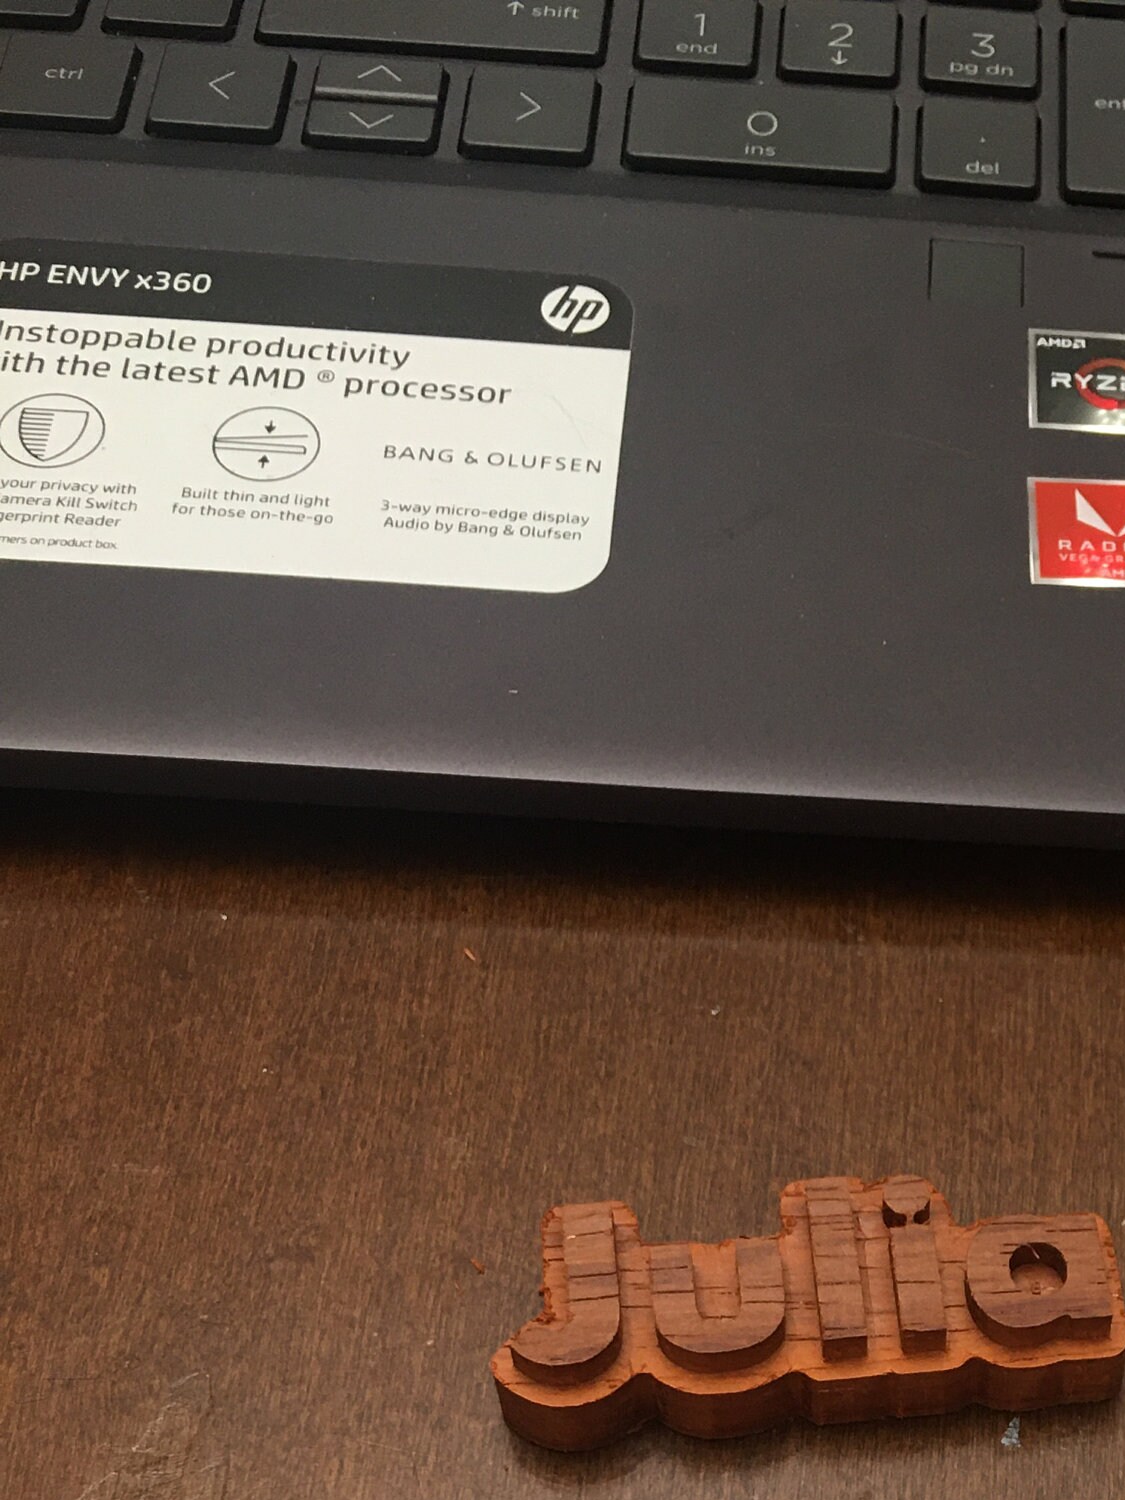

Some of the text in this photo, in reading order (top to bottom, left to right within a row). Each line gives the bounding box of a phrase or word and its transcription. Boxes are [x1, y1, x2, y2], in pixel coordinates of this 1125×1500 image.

[531, 6, 580, 20] shift
[694, 13, 706, 37] 1
[829, 23, 854, 49] 2
[675, 43, 719, 55] end
[970, 33, 996, 58] 3
[44, 66, 84, 80] ctrl
[949, 61, 1014, 77] pg dn
[743, 145, 776, 157] ins
[964, 160, 1000, 175] del
[0, 260, 212, 294] HP ENVY x360
[543, 284, 608, 334] hp
[0, 320, 411, 370] nstoppable productivity
[1036, 337, 1073, 349] AMD
[0, 351, 45, 374] ith
[56, 354, 111, 378] the
[121, 357, 220, 384] latest
[344, 376, 512, 404] processor
[383, 444, 602, 474] BANG & OLUFSEN
[0, 479, 137, 494] your privacy with
[181, 486, 331, 508] Built thin and light
[0, 495, 138, 512] amera Kill Switch
[172, 502, 334, 526] for those on-the-go
[380, 499, 590, 527] 3-way micro-edge display
[64, 512, 122, 527] Reader
[383, 516, 583, 541] Audio by Bang & Olufsen
[29, 537, 46, 545] on
[47, 538, 93, 549] product
[95, 539, 119, 550] box
[508, 1175, 1114, 1388] Julia
